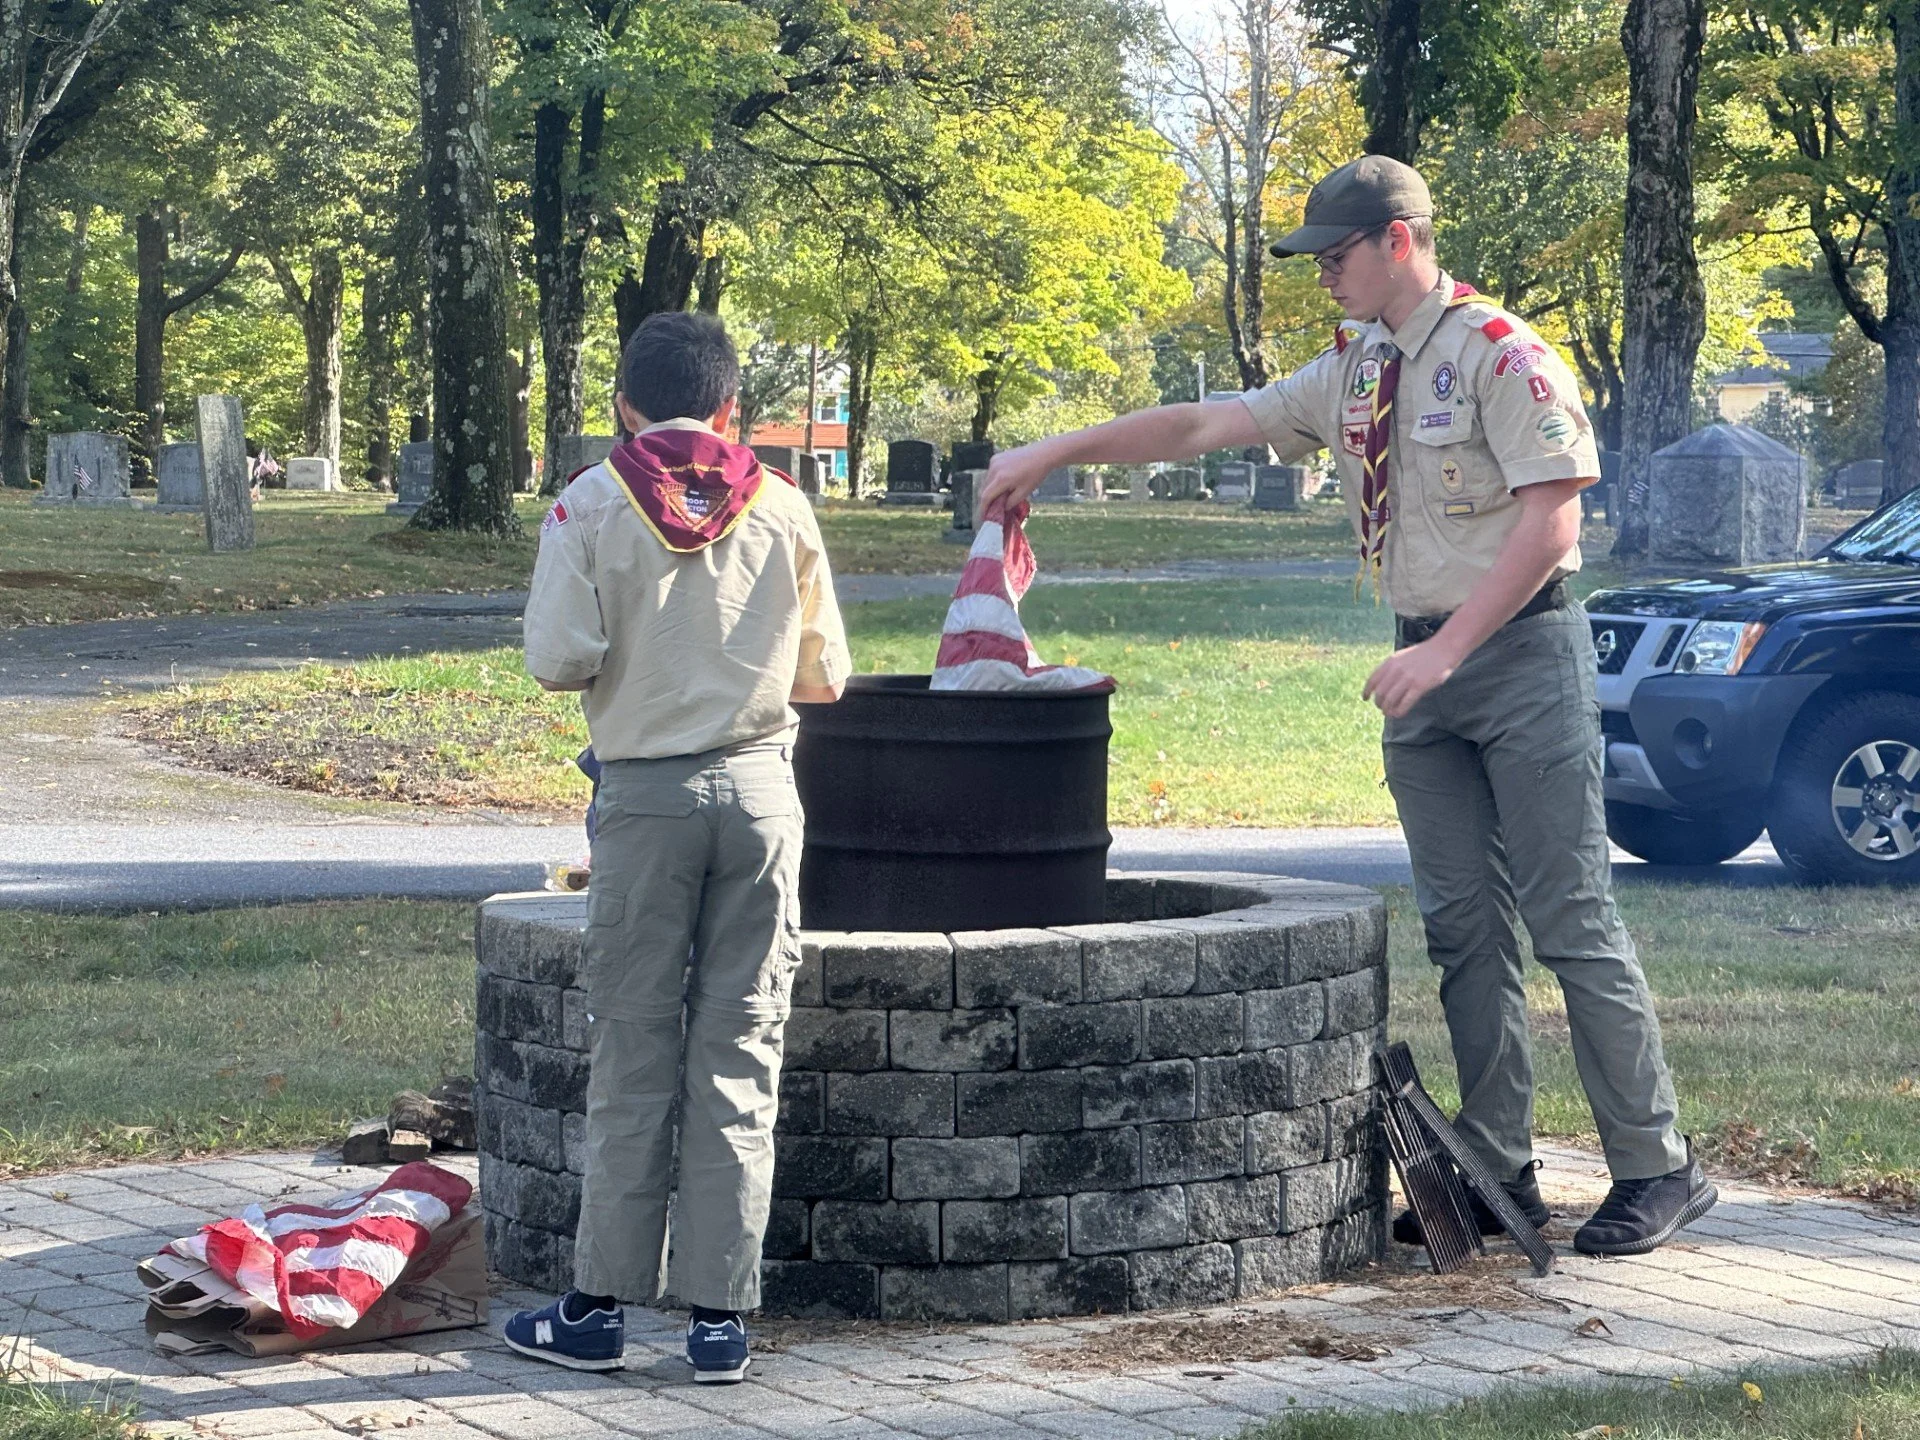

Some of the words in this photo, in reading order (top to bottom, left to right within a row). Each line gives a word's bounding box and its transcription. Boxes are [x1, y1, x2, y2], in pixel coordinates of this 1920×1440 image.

[1506, 343, 1532, 360] ACTON
[1534, 379, 1547, 399] 1
[535, 1319, 553, 1344] N
